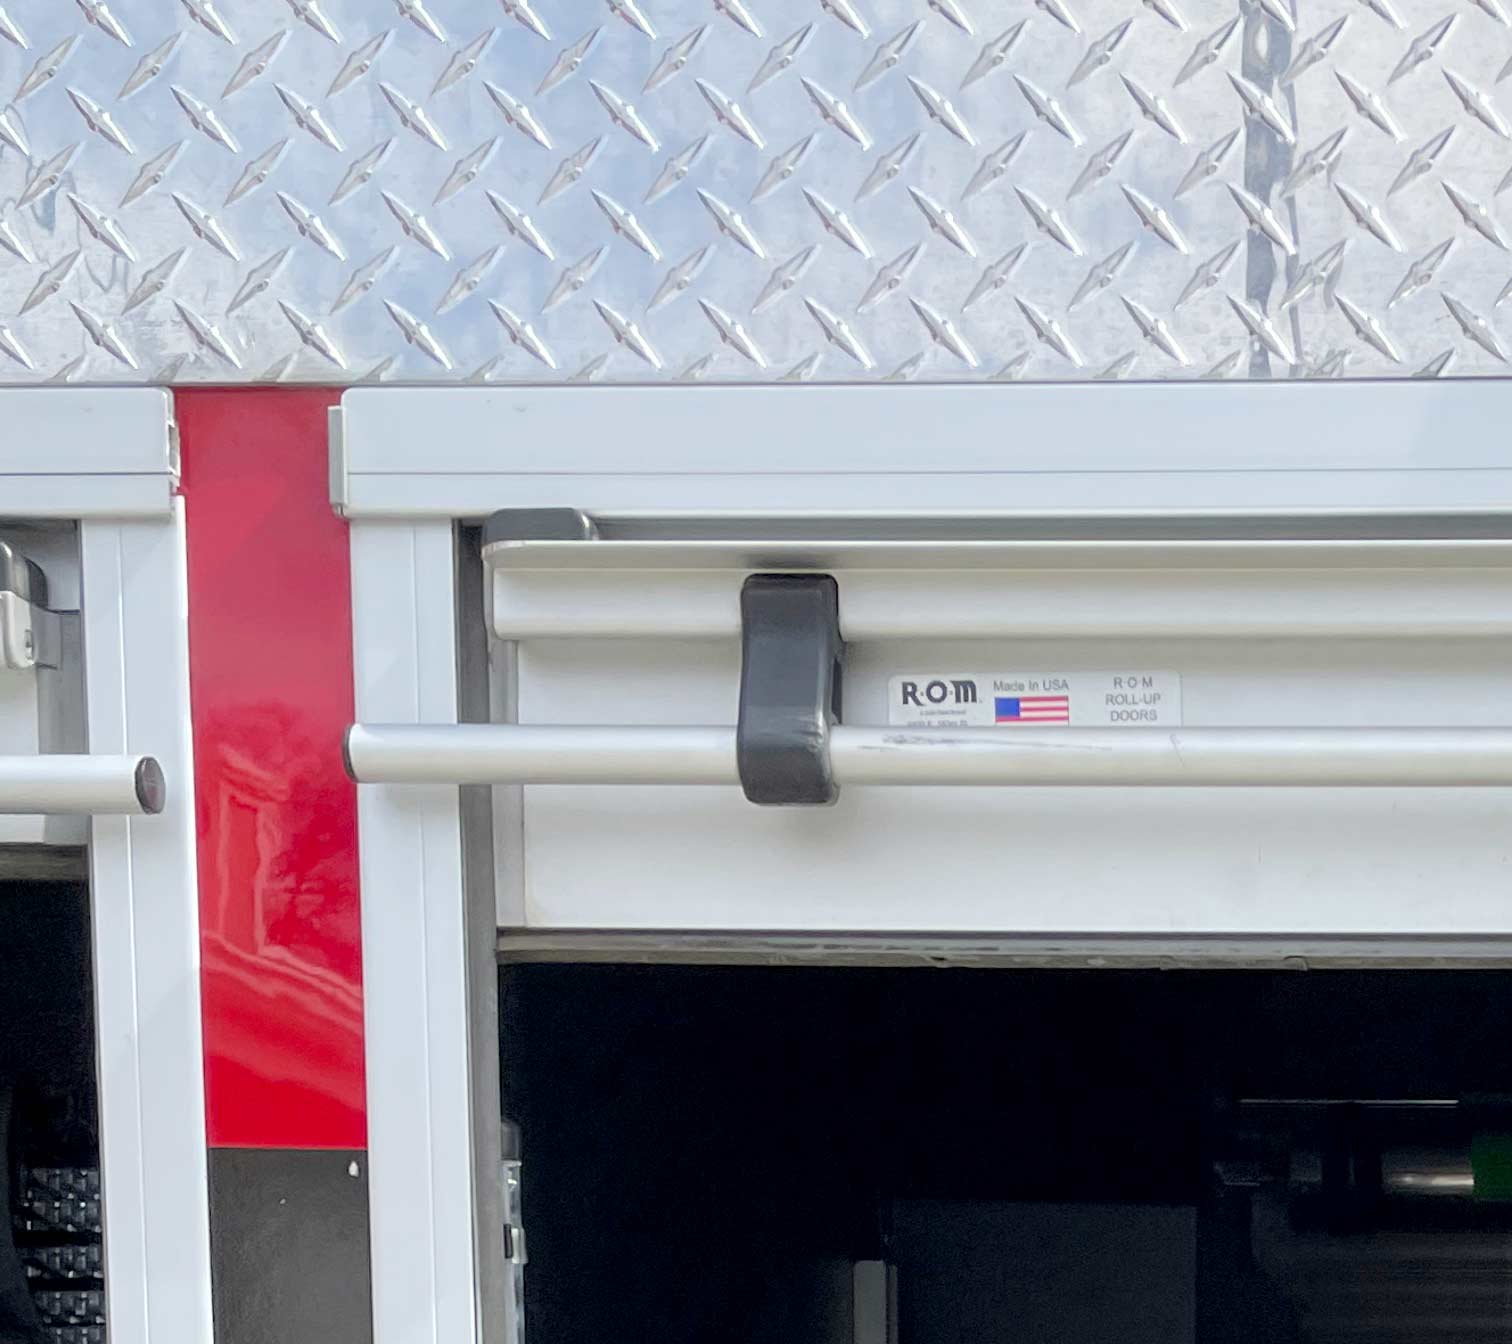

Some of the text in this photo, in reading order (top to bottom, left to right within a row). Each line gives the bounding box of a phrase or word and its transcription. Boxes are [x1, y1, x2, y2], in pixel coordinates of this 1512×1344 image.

[993, 678, 1070, 692] Made In USA
[1105, 693, 1161, 706] ROLL-UP
[1110, 710, 1158, 722] DOORS
